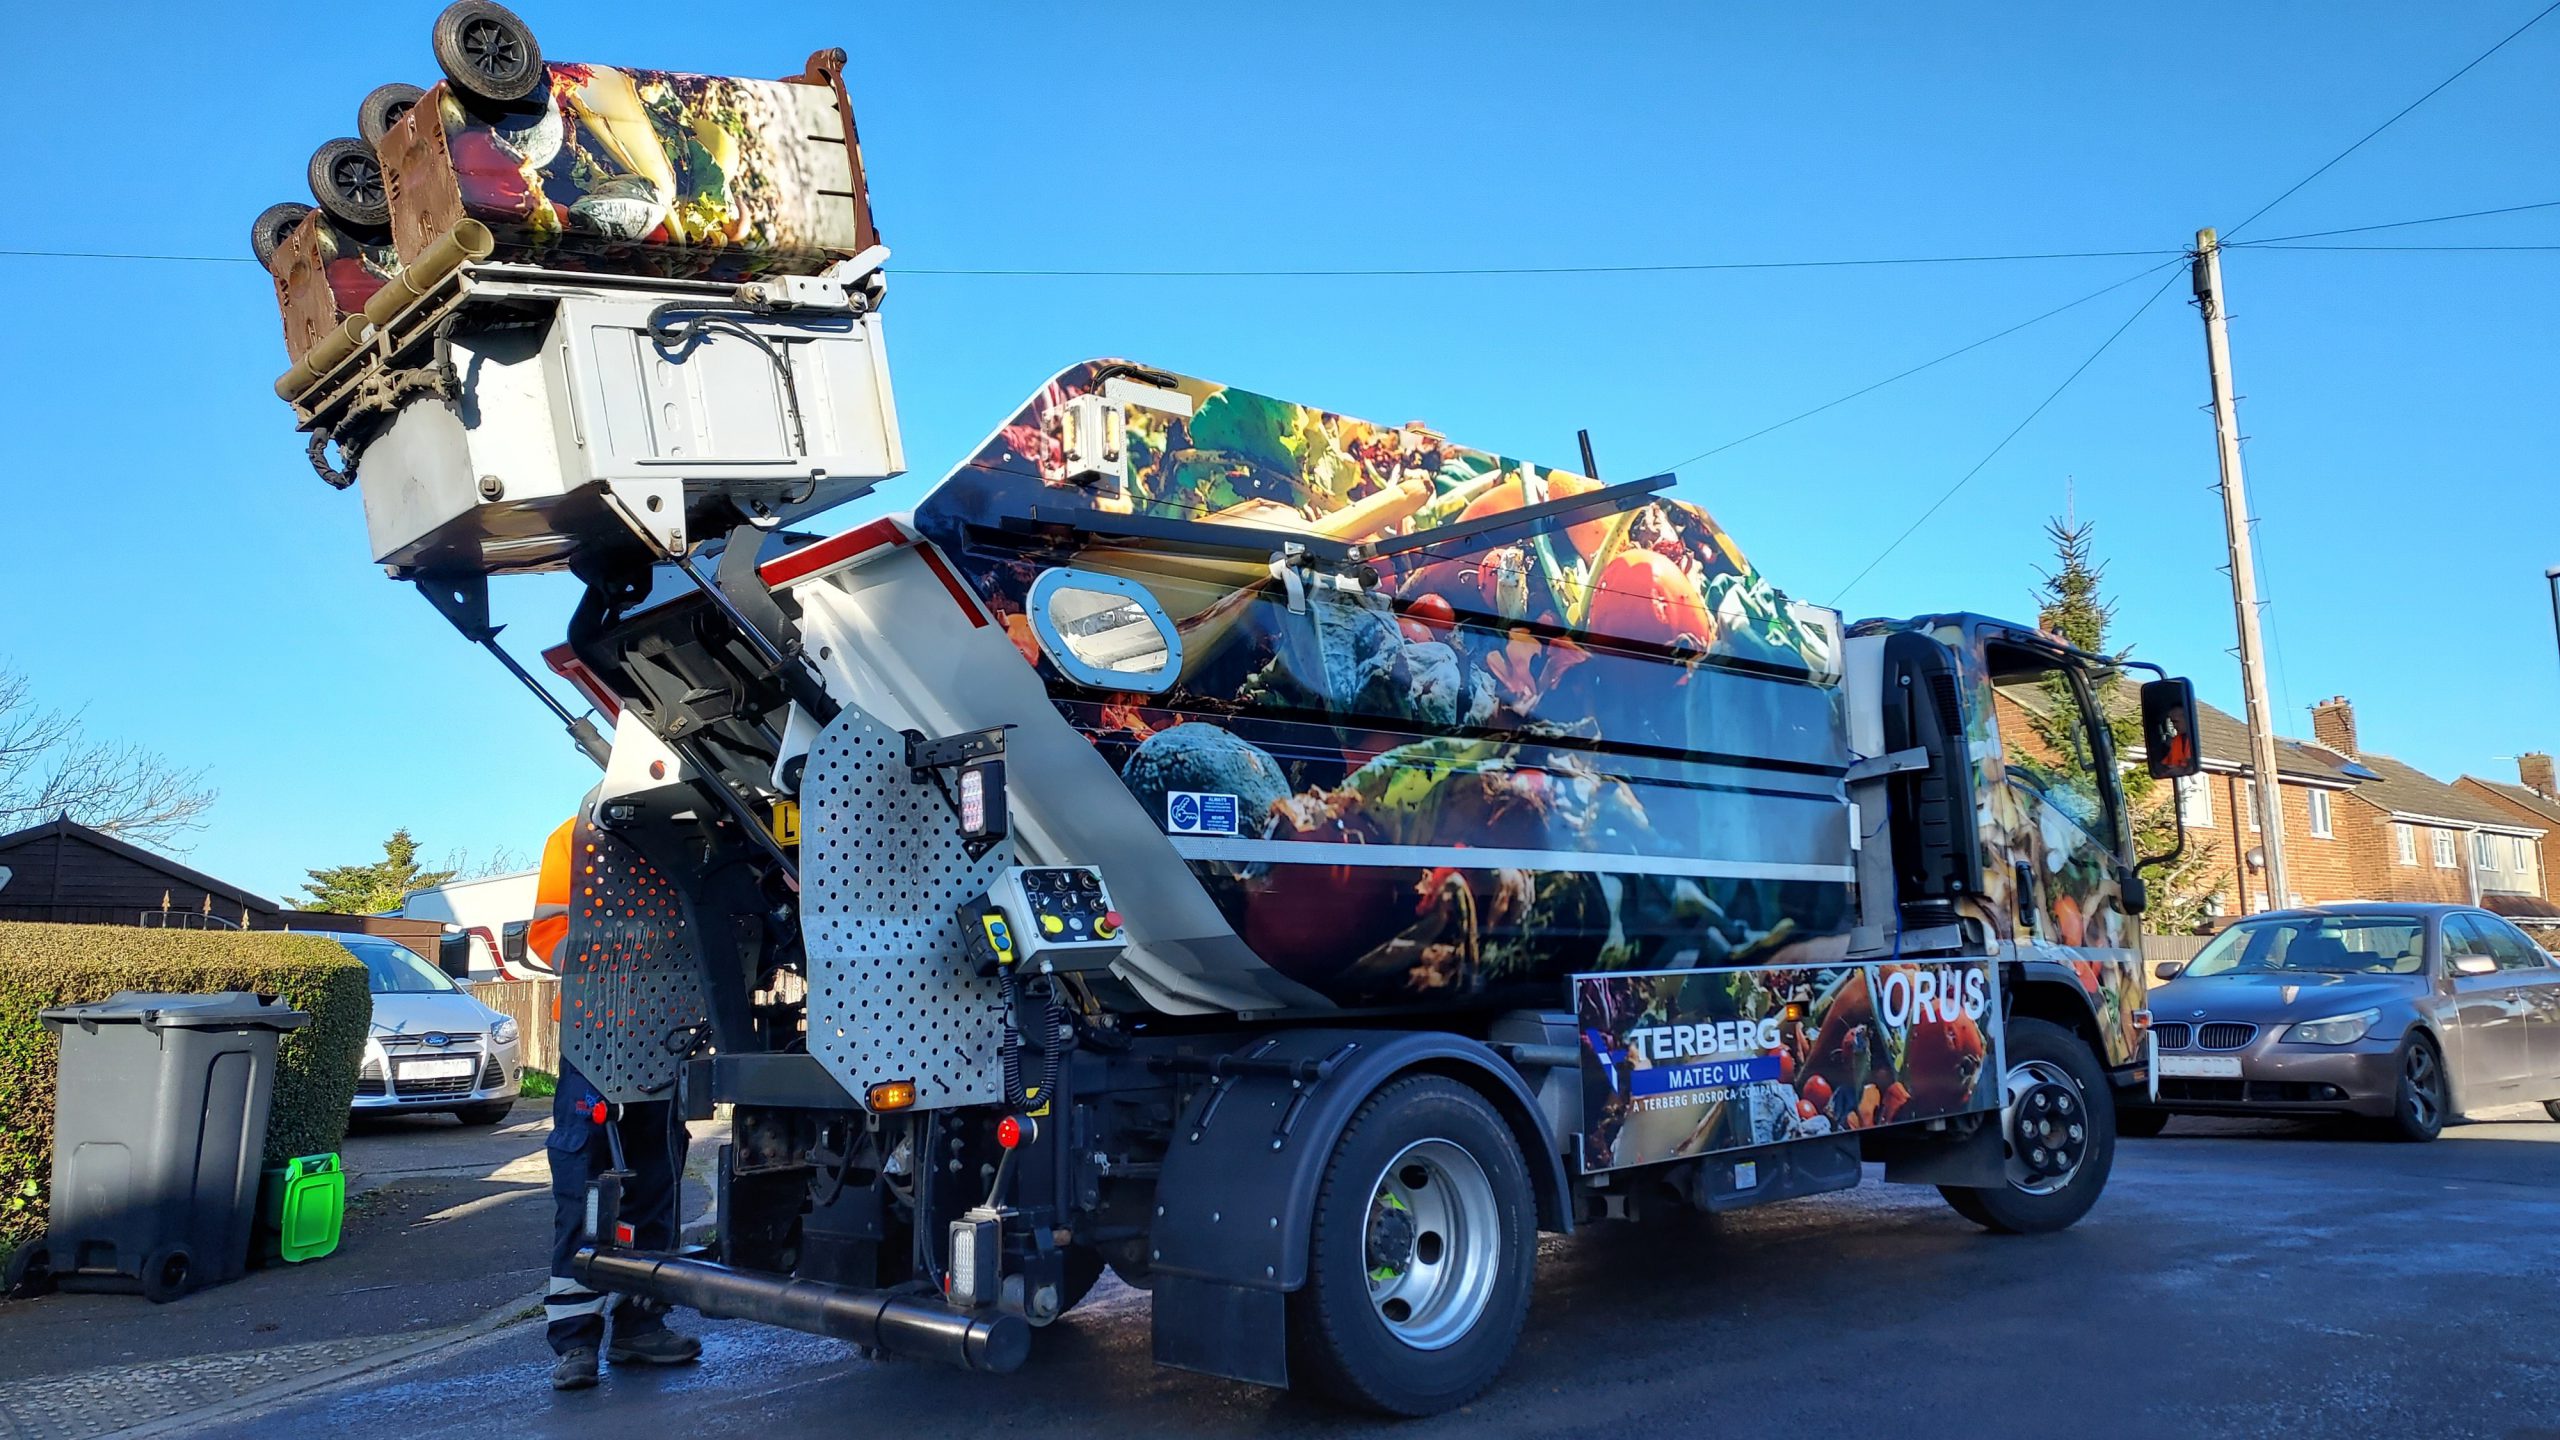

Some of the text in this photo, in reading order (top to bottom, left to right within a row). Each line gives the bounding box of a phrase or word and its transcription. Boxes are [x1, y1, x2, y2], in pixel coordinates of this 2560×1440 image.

[1883, 967, 1985, 1028] ORUS
[1630, 1018, 1780, 1061] TERBERG
[1669, 1063, 1750, 1089] MATEC UK
[1632, 1101, 1640, 1113] A
[1643, 1095, 1688, 1111] TERBERG
[1692, 1088, 1737, 1106] ROSROCA
